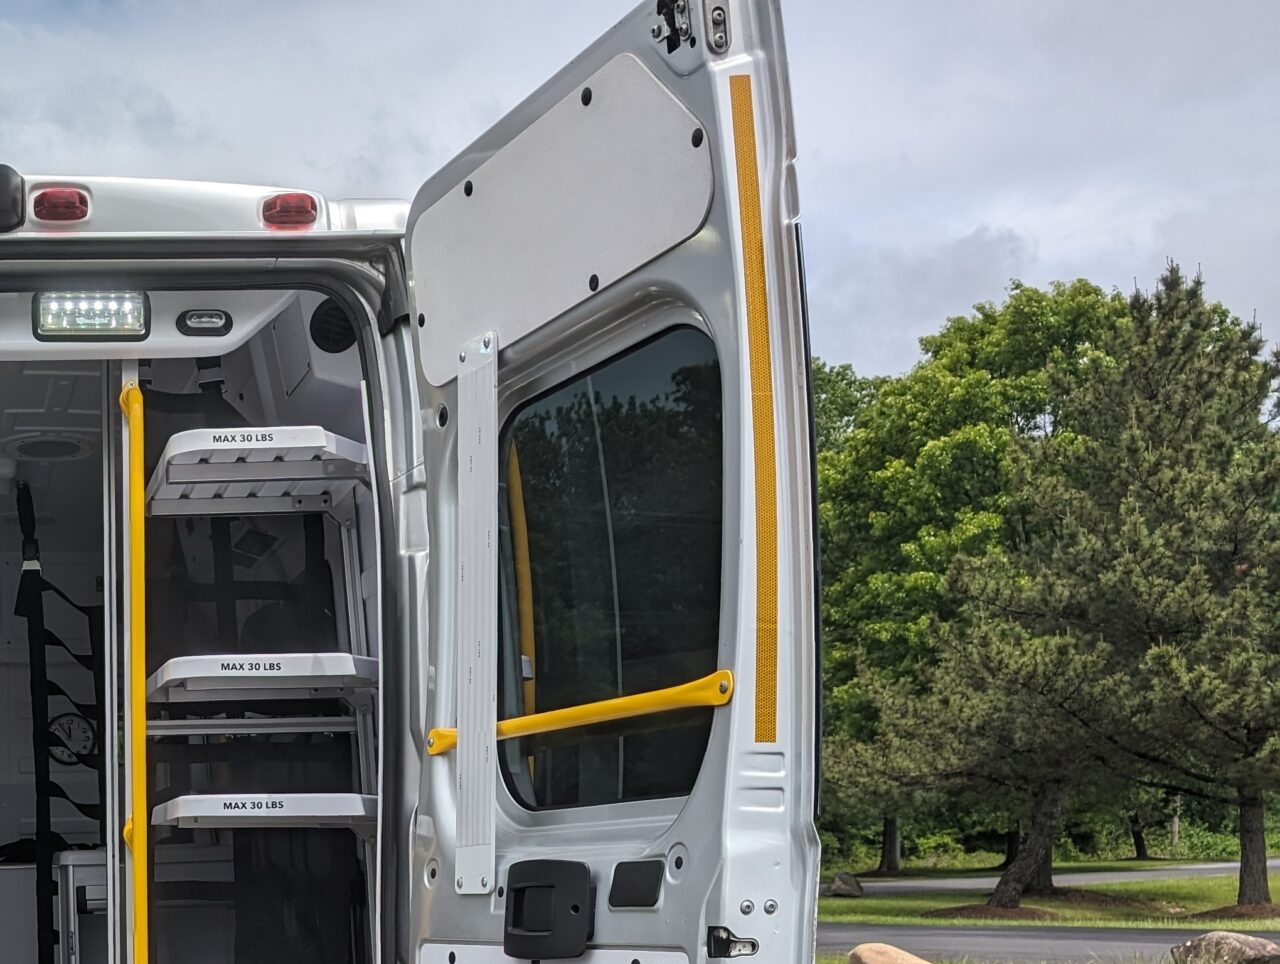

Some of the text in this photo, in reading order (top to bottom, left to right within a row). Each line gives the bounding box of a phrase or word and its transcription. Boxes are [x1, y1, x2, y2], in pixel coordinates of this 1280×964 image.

[212, 433, 274, 443] MAX 30 LBS
[220, 662, 282, 671] MAX 30 LBS
[223, 800, 284, 810] MAX 30 LBS
